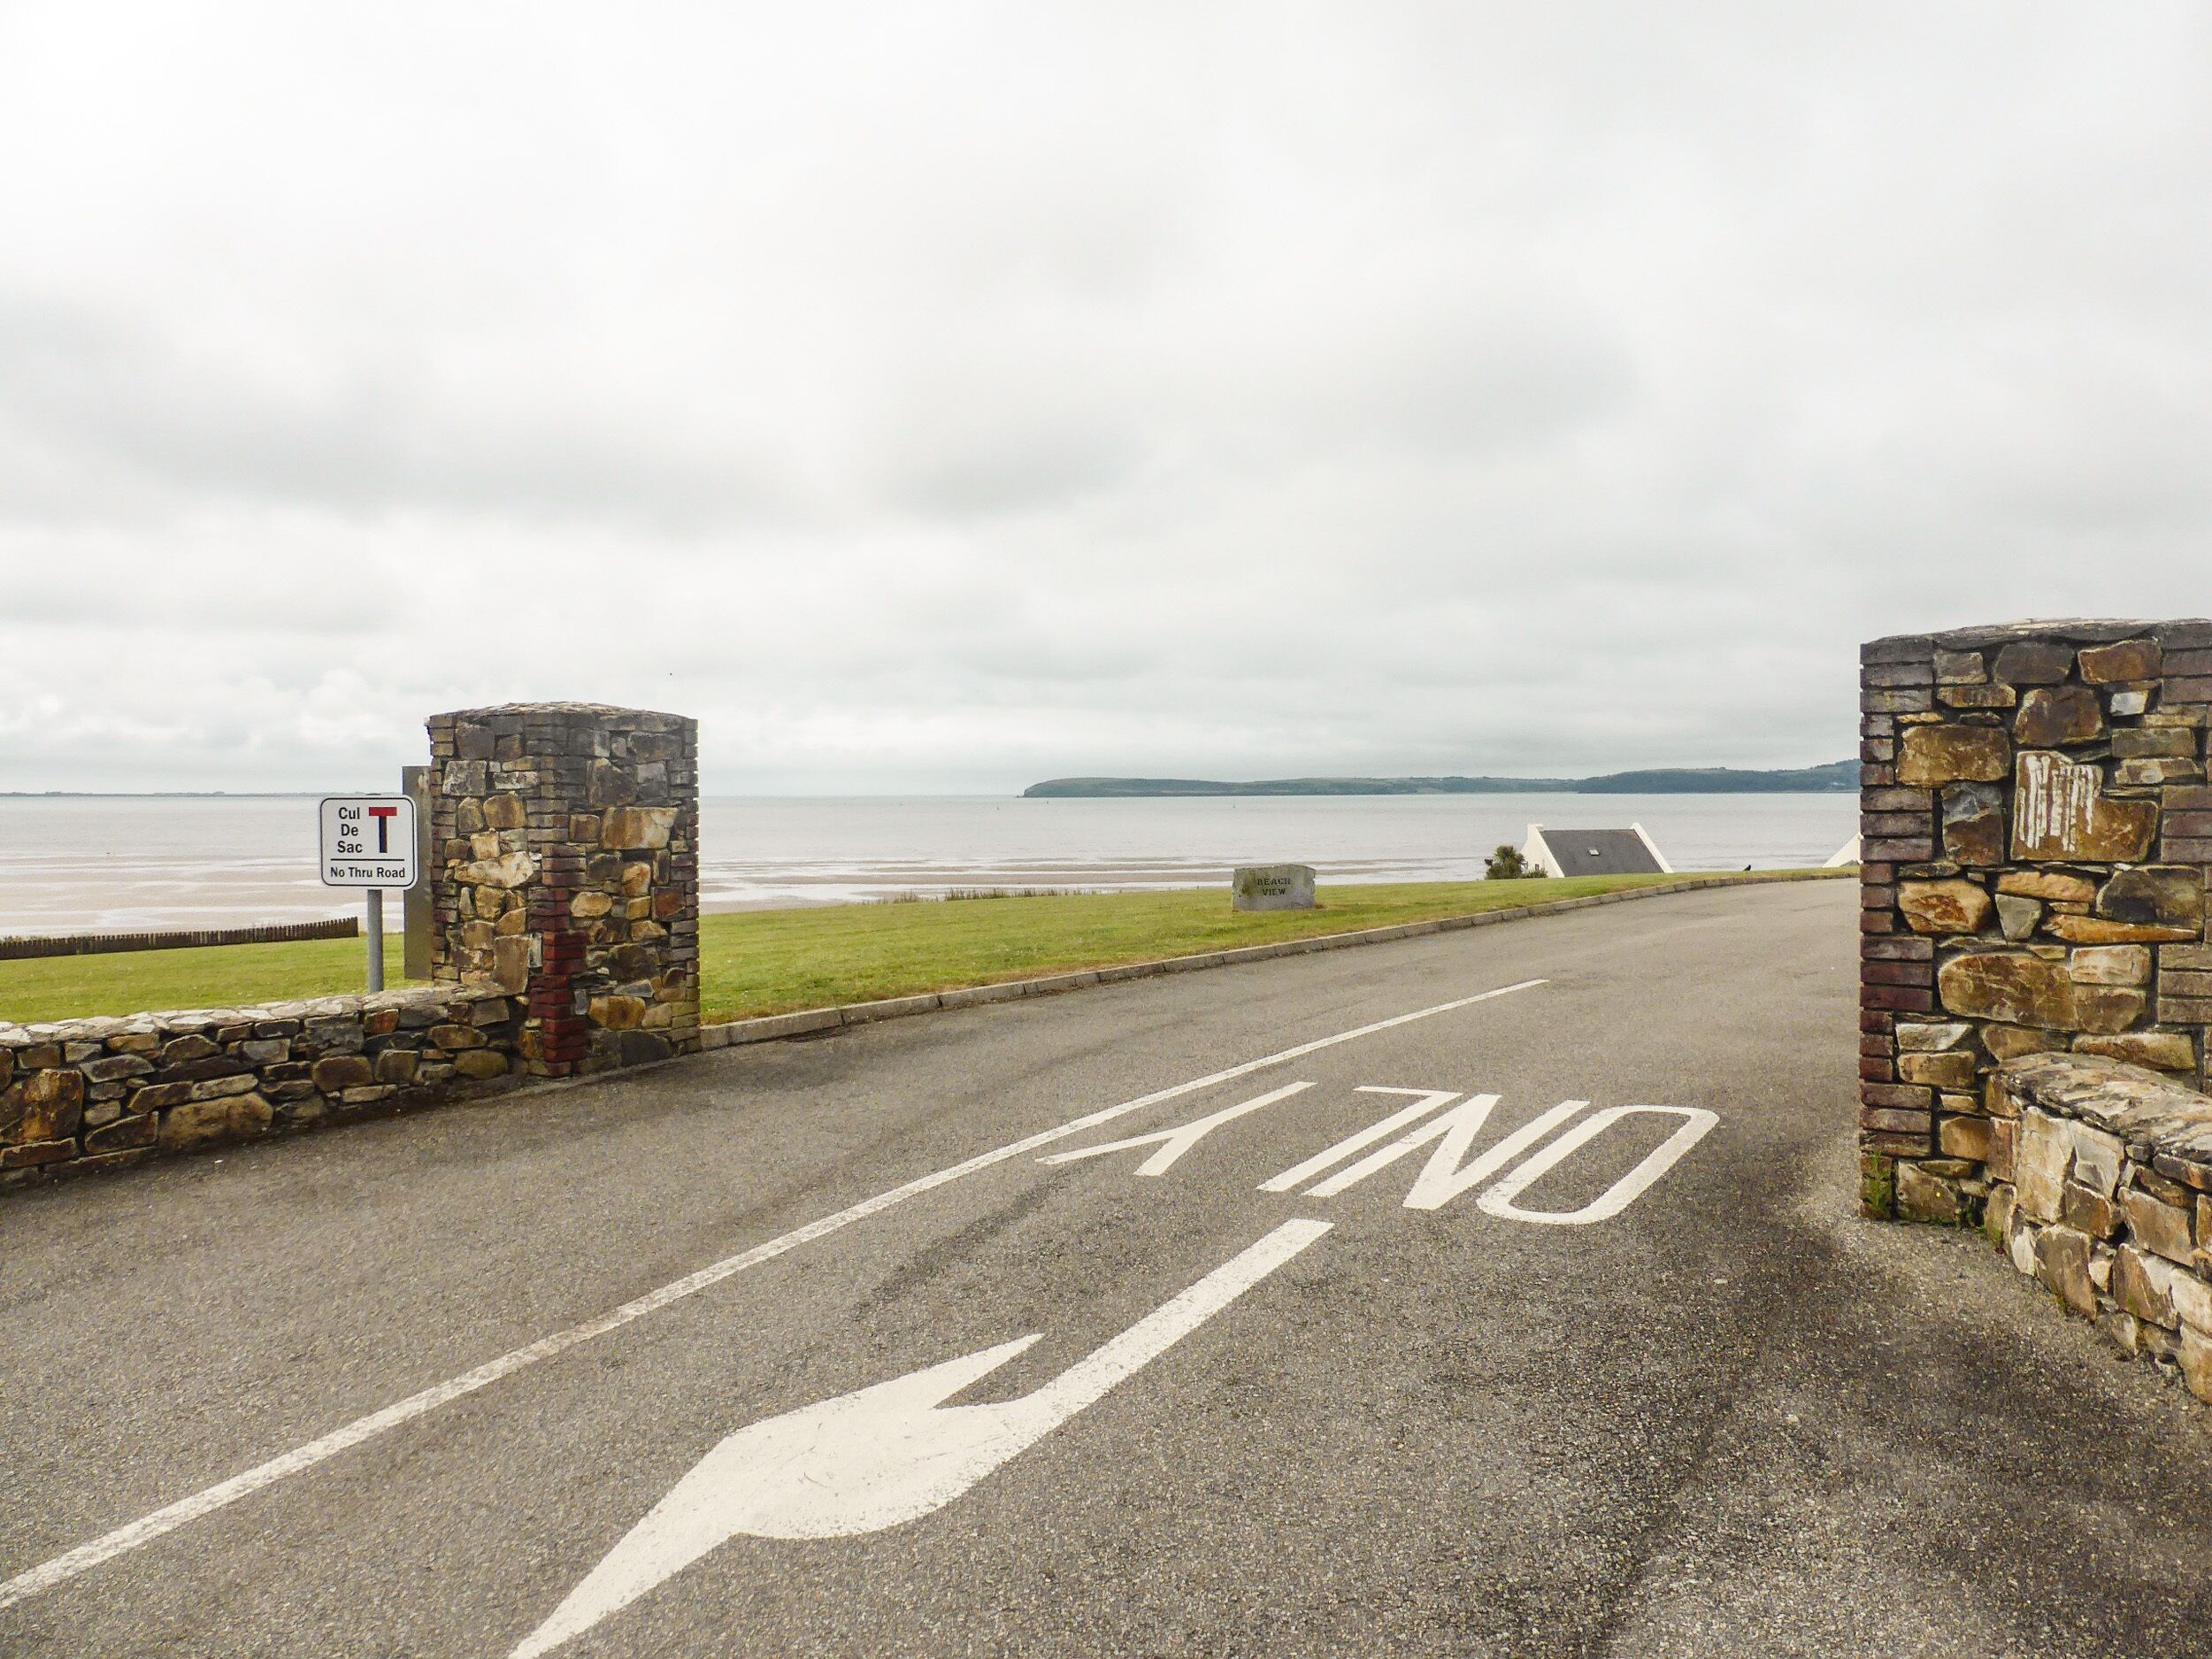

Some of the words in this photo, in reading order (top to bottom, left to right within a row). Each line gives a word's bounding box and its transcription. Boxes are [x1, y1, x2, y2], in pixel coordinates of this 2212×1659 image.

[338, 807, 360, 819] Cul
[341, 824, 358, 836] De
[337, 841, 363, 853] Sac
[331, 867, 345, 878] No
[349, 867, 373, 878] Thru
[377, 867, 405, 878] Road
[1034, 1081, 1720, 1225] ONLY
